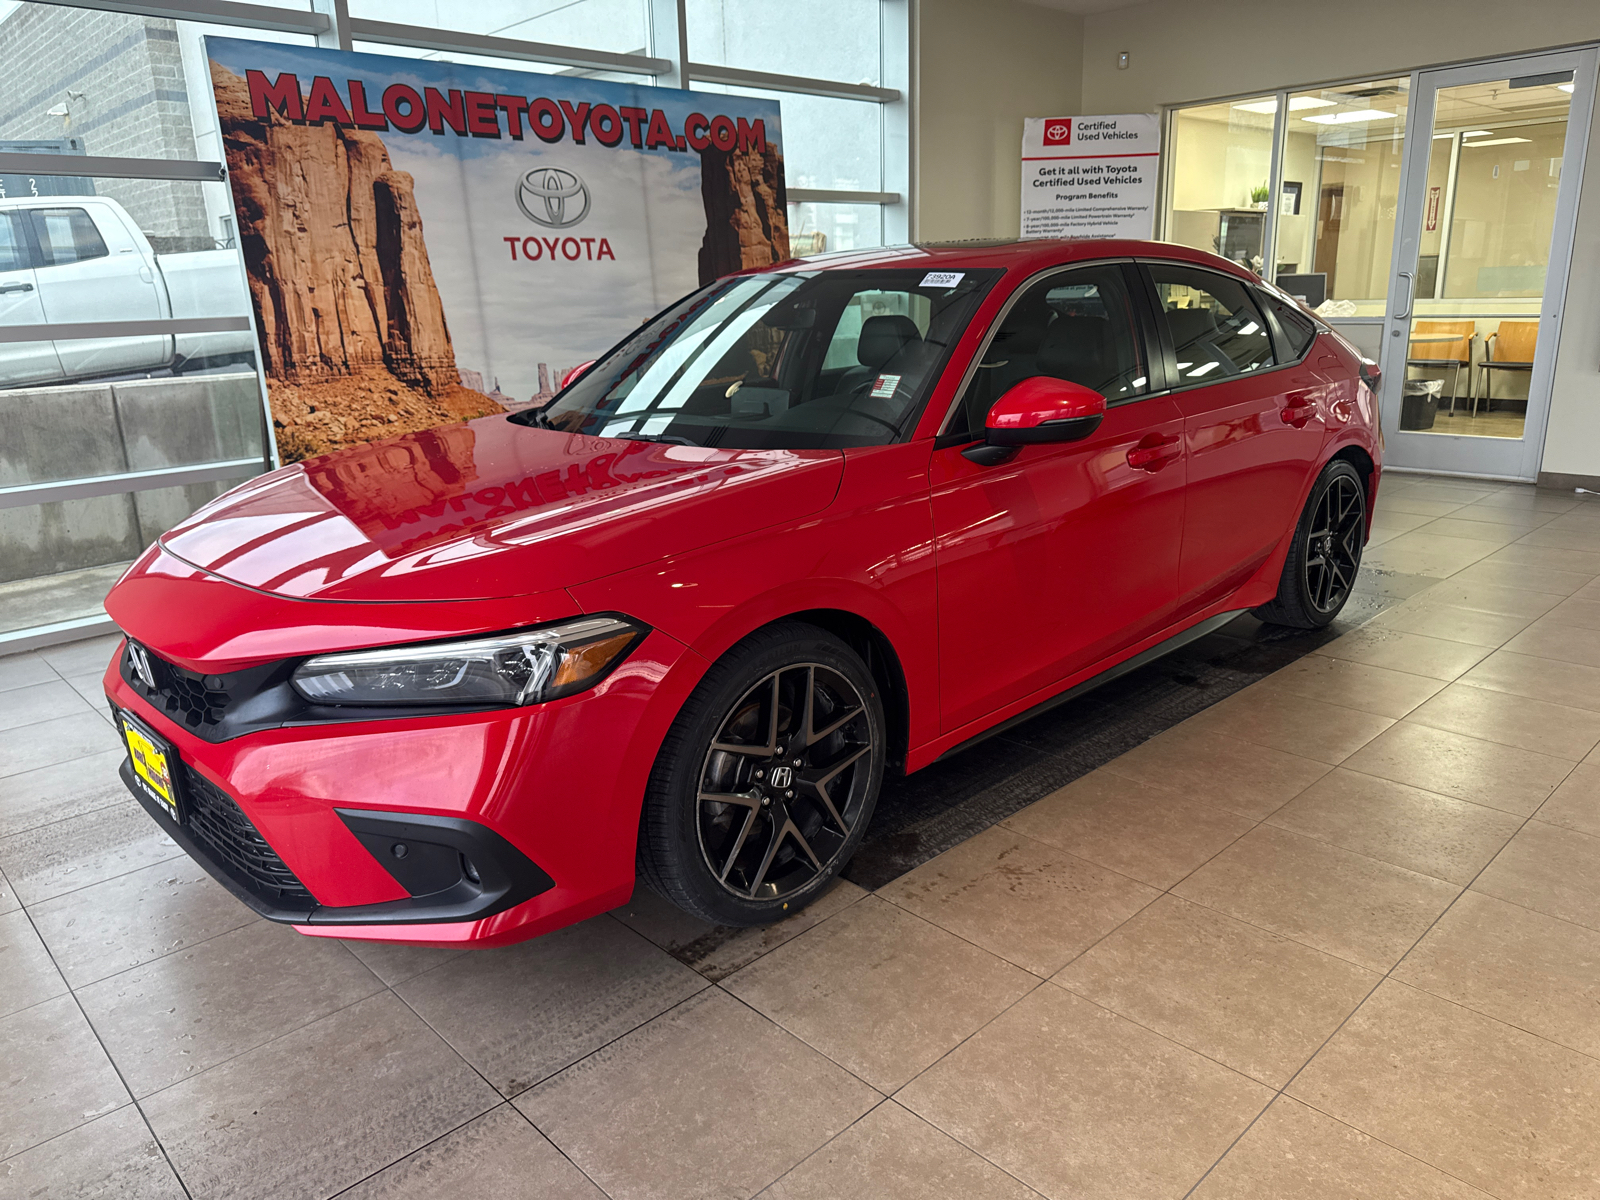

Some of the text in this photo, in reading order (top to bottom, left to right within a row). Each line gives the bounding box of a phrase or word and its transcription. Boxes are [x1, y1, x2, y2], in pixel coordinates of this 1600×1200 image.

[245, 69, 766, 153] MALONETOYOTA.COM
[1077, 121, 1116, 130] Certified
[1077, 130, 1138, 141] Used Vehicles
[1038, 165, 1138, 176] Get it all with Toyota
[1032, 175, 1142, 187] Certified Used Vehicles
[1055, 192, 1118, 202] Program Benefits
[503, 236, 616, 261] TOYOTA
